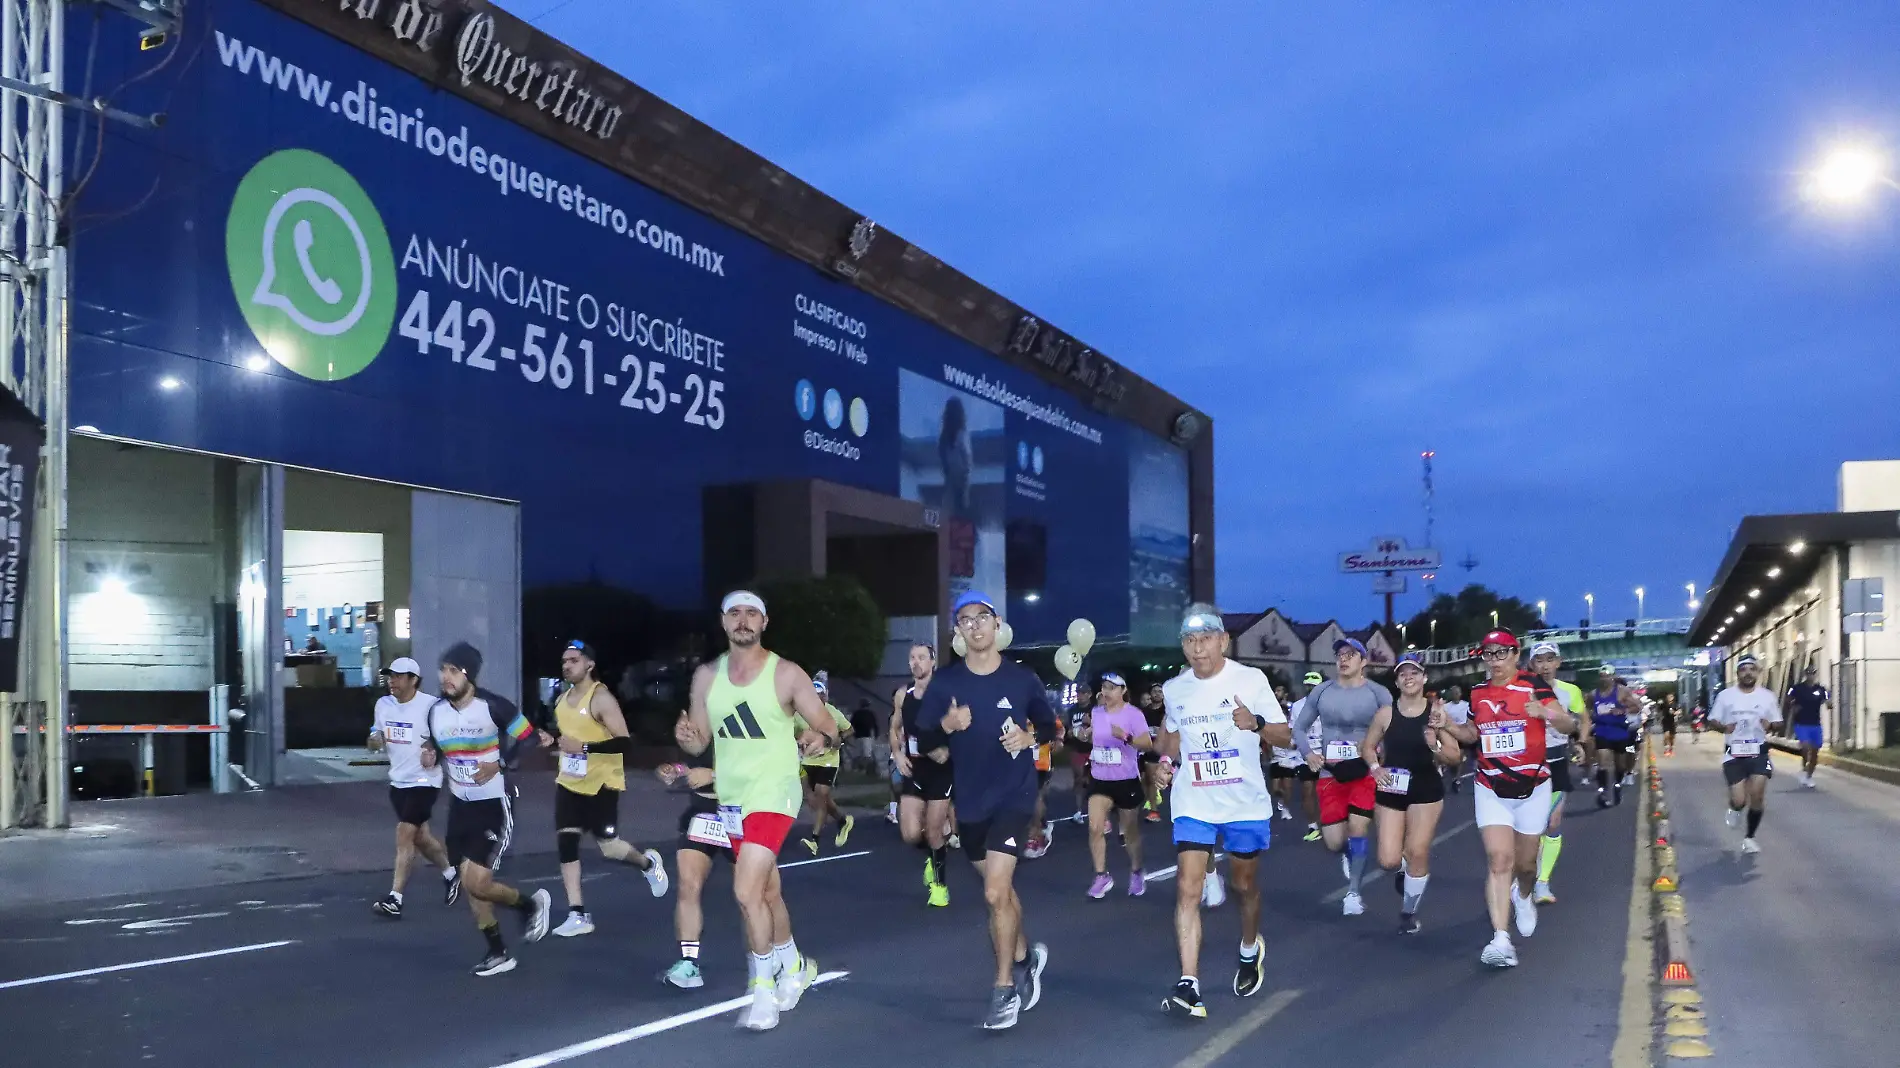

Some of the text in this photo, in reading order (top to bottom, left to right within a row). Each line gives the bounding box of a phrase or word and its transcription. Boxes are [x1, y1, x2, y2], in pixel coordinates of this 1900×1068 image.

[215, 30, 726, 277] www.diariodequeretaro.com.mx
[401, 233, 725, 372] ANÚNCIATE O SUSCRÍBETE
[795, 293, 868, 339] CLASIFICADO
[398, 289, 726, 430] 442-561-25-25
[793, 319, 837, 353] Impreso
[845, 340, 869, 365] Web
[1344, 554, 1432, 569] Sanborns
[1477, 721, 1497, 731] VALLE
[1497, 719, 1529, 728] RUNNERS
[1495, 734, 1514, 749] 860
[1205, 760, 1228, 777] 402
